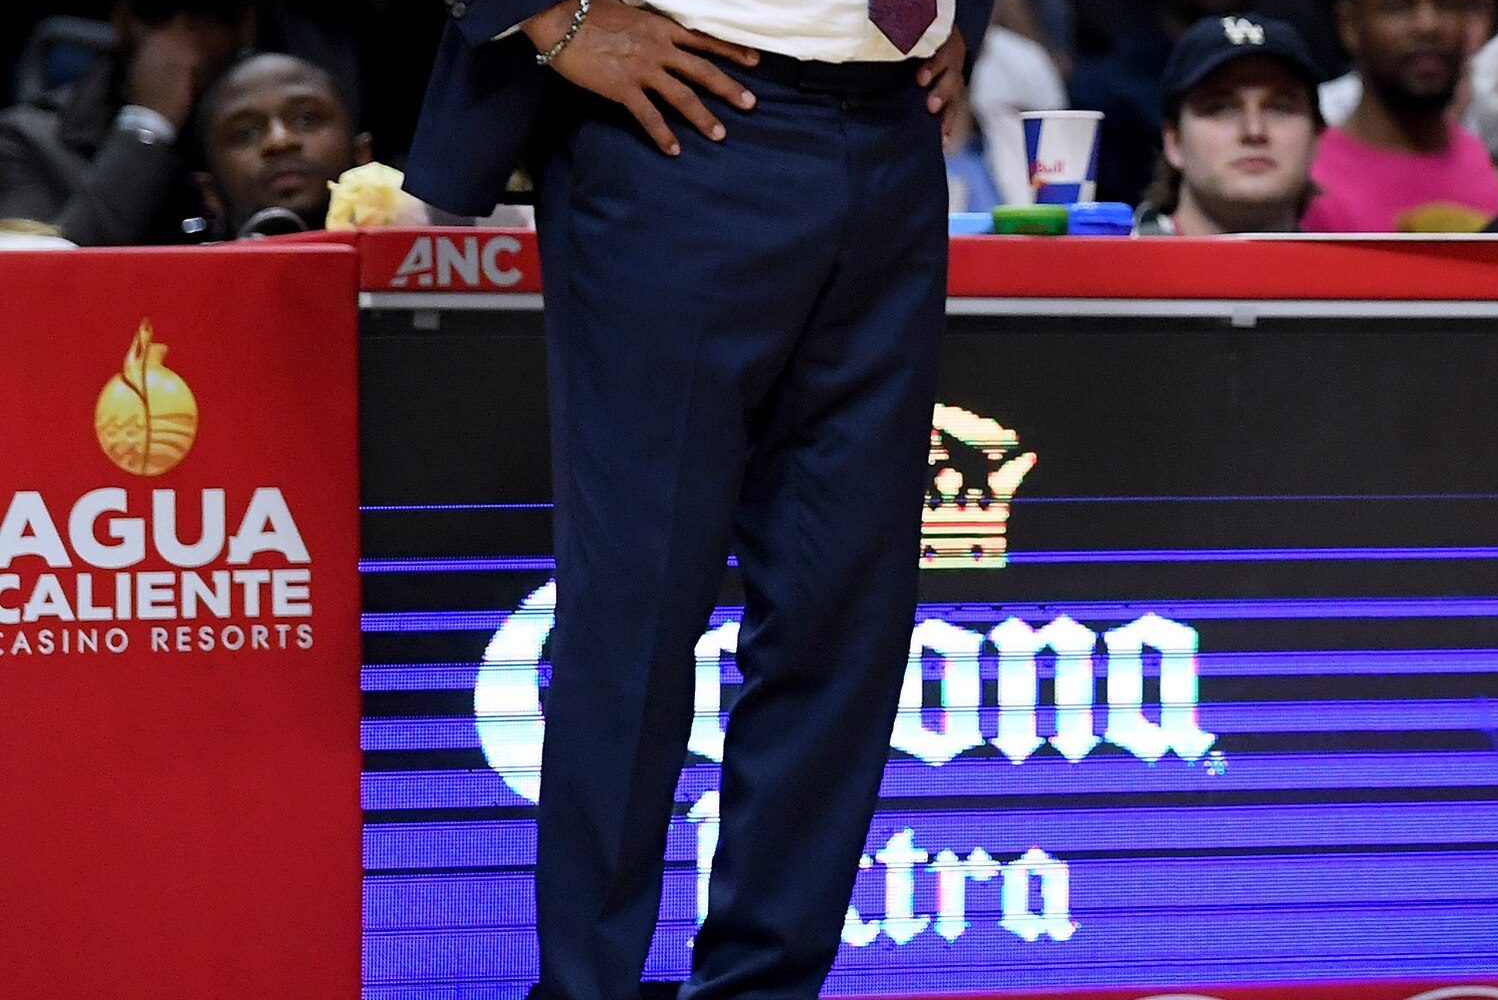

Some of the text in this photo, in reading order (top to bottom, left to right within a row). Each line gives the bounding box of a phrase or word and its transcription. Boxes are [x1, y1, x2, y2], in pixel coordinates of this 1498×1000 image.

[390, 236, 523, 287] ANC
[0, 487, 312, 569] AGUA
[0, 568, 312, 624] CALIENTE
[151, 624, 313, 652] RESORTS
